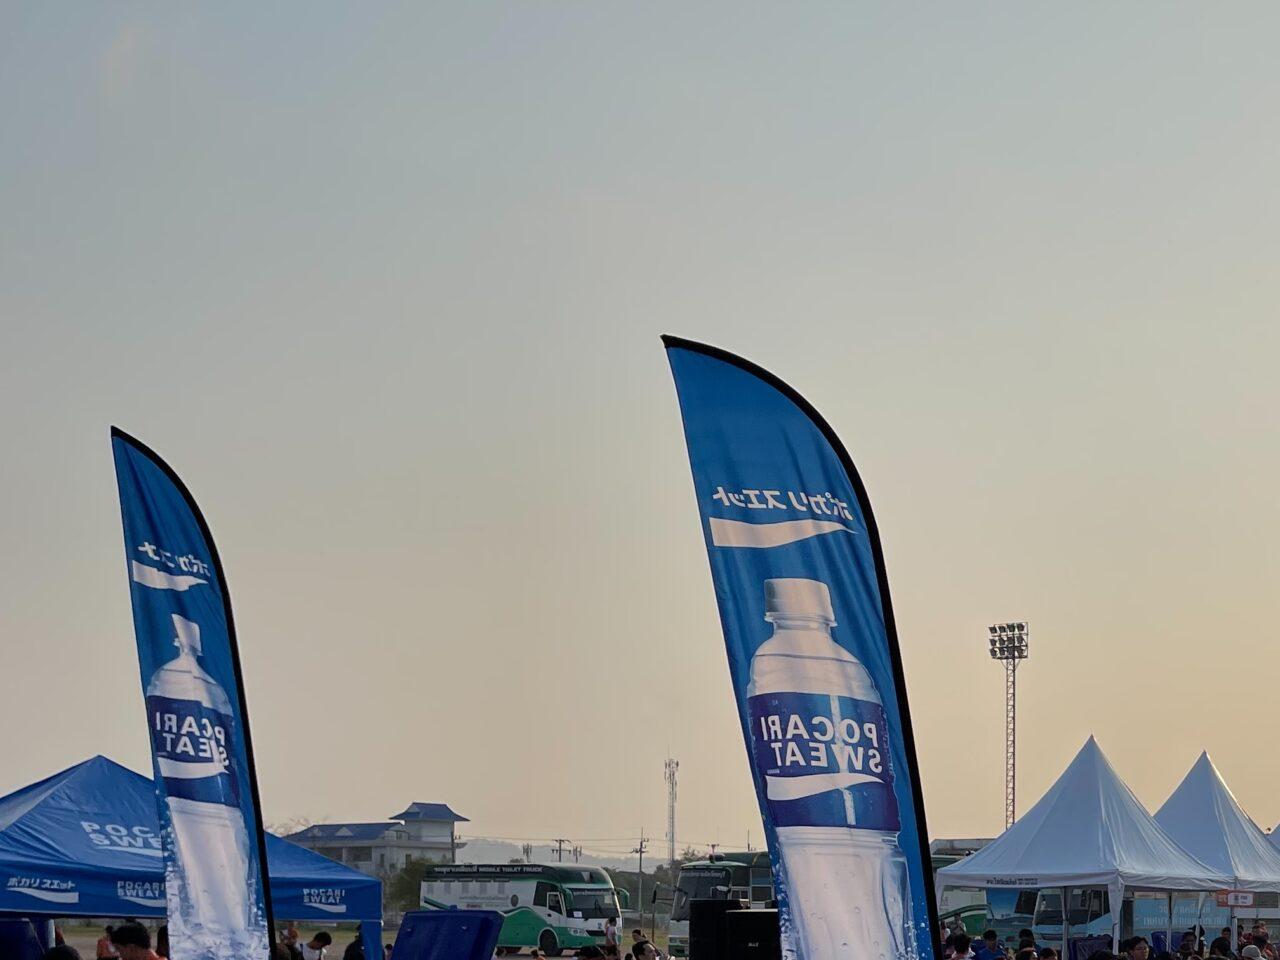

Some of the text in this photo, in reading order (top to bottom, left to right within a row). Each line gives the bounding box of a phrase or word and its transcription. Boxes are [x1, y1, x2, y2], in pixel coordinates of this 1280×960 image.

[81, 821, 154, 838] POC
[89, 832, 161, 849] SWE
[303, 888, 345, 897] POCARI
[303, 896, 341, 904] SWEAT
